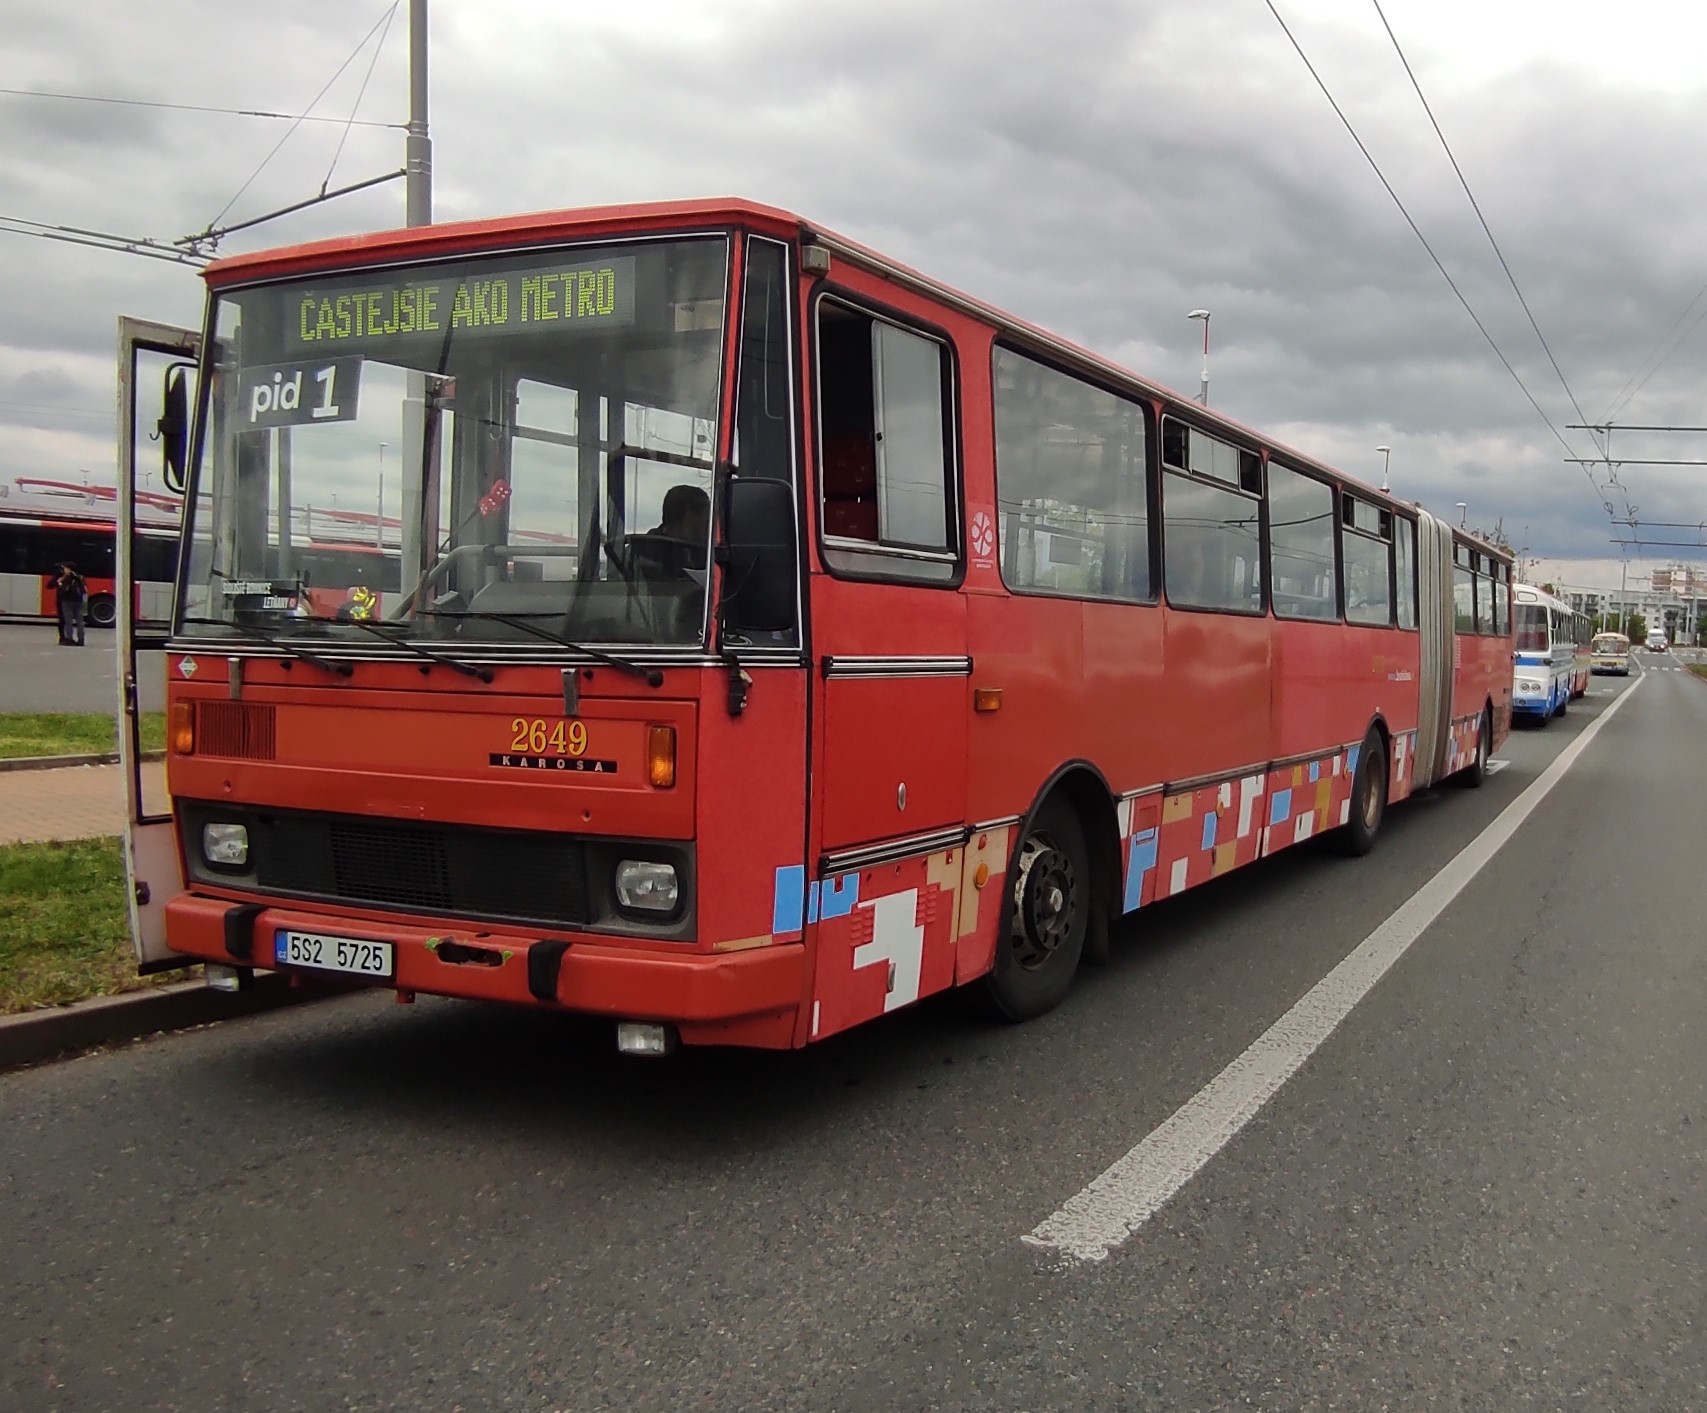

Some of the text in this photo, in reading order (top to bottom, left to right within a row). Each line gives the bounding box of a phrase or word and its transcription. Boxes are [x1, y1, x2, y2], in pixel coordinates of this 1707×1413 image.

[451, 280, 508, 328] AKO
[521, 268, 615, 322] METRO
[250, 365, 340, 423] pid 1
[511, 717, 588, 756] 2649
[502, 755, 604, 772] KAROSA
[291, 936, 383, 971] 5S2 5725
